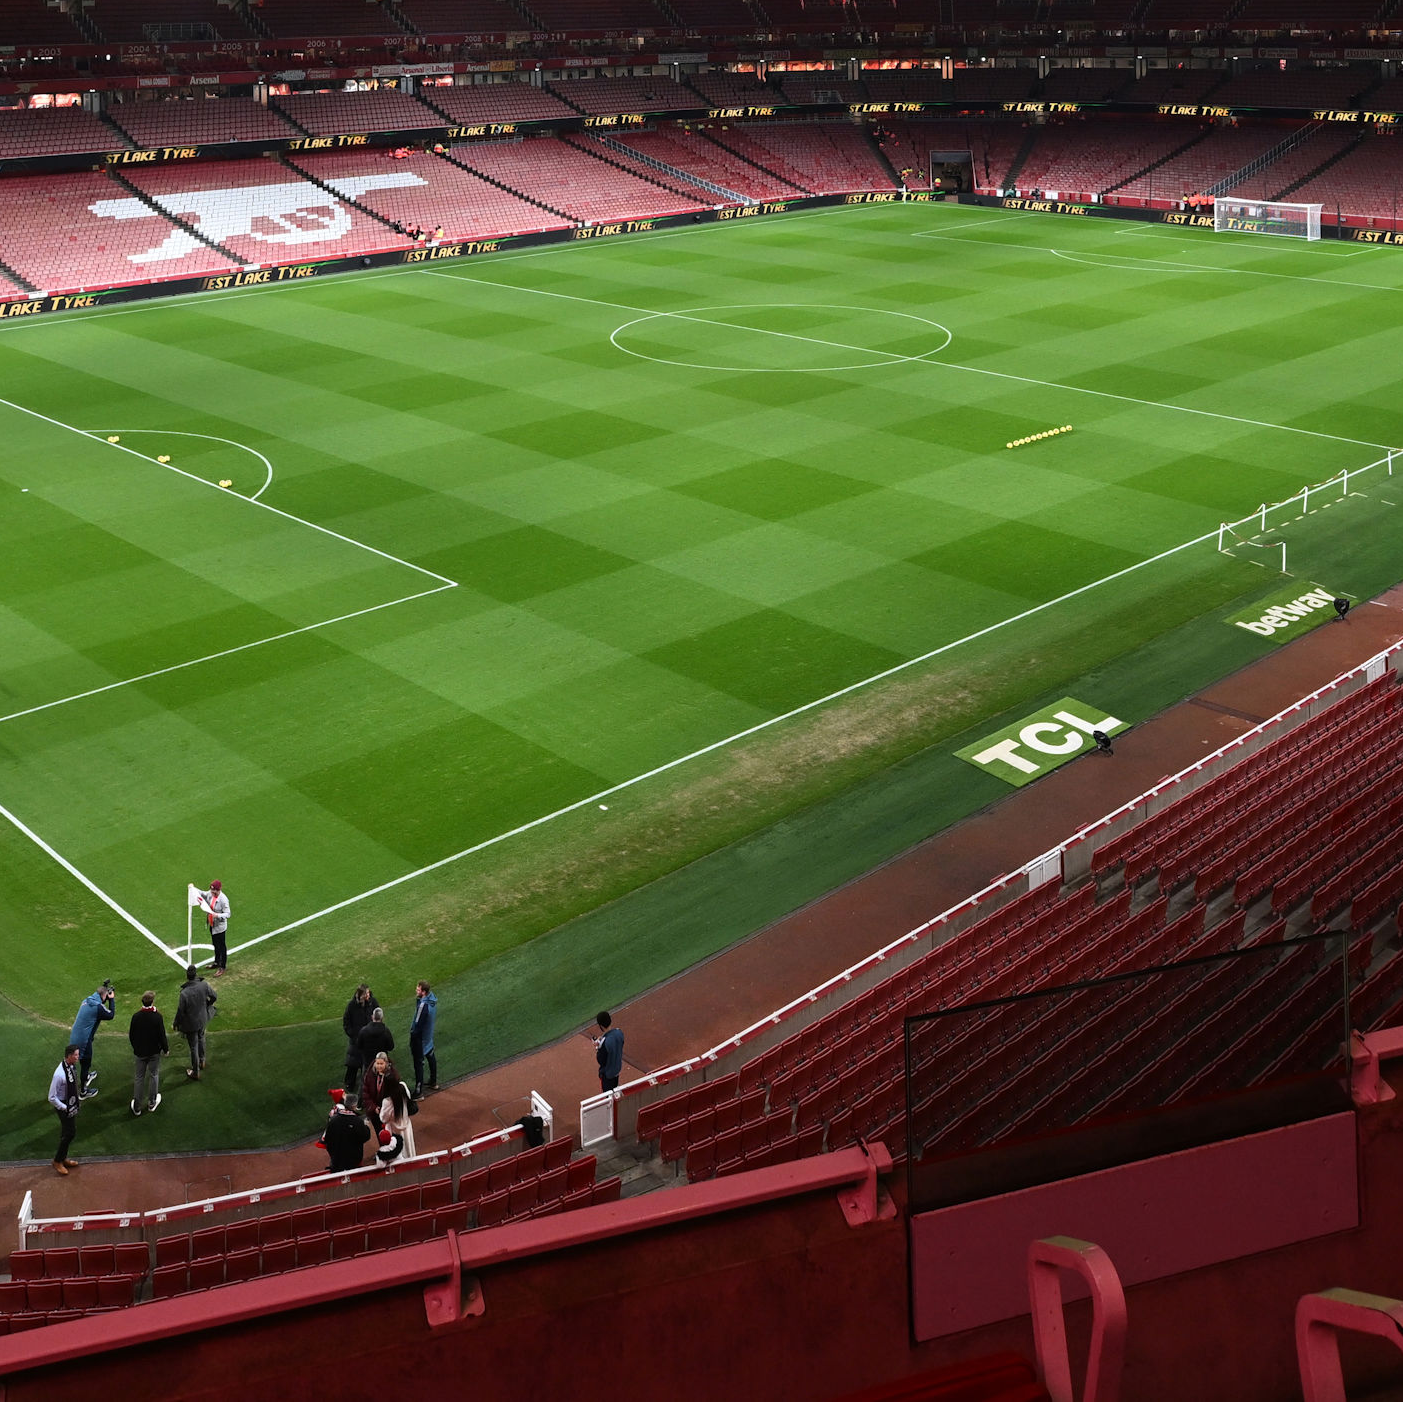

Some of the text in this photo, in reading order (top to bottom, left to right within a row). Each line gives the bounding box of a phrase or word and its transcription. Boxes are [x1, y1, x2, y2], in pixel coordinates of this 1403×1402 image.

[128, 45, 150, 53] 2004
[222, 42, 242, 50] 2005
[306, 40, 326, 48] 2006
[38, 48, 61, 56] 2003
[1309, 50, 1336, 58] Arsenal
[466, 64, 489, 72] Arsenal
[190, 75, 219, 85] Arsenal
[720, 108, 744, 118] LAKE
[747, 106, 774, 116] TYRE
[862, 103, 890, 113] LAKE
[893, 102, 922, 112] TYRE
[1016, 102, 1044, 112] LAKE
[1048, 102, 1078, 113] TYRE
[1171, 105, 1198, 116] LAKE
[1201, 106, 1230, 117] TYRE
[596, 116, 618, 126] LAKE
[621, 114, 644, 124] TYRE
[1327, 110, 1359, 122] LAKE
[1363, 112, 1396, 124] TYRE
[460, 126, 486, 136] LAKE
[489, 124, 515, 134] TYRE
[304, 137, 333, 149] LAKE
[337, 135, 368, 146] TYRE
[122, 150, 157, 163] LAKE
[162, 147, 197, 159] TYRE
[845, 194, 865, 204] EST
[866, 193, 896, 203] LAKE
[717, 204, 786, 220] EST LAKE TYRE
[1002, 199, 1086, 215] EST LAKE TYRE
[1162, 213, 1187, 224] EST
[572, 221, 653, 240] EST LAKE TYRE
[1352, 229, 1382, 243] EST
[403, 242, 498, 263] EST LAKE TYRE
[201, 266, 314, 290] EST LAKE TYRE
[51, 296, 95, 311] TYRE
[1235, 587, 1336, 637] betway
[972, 711, 1123, 774] TCL
